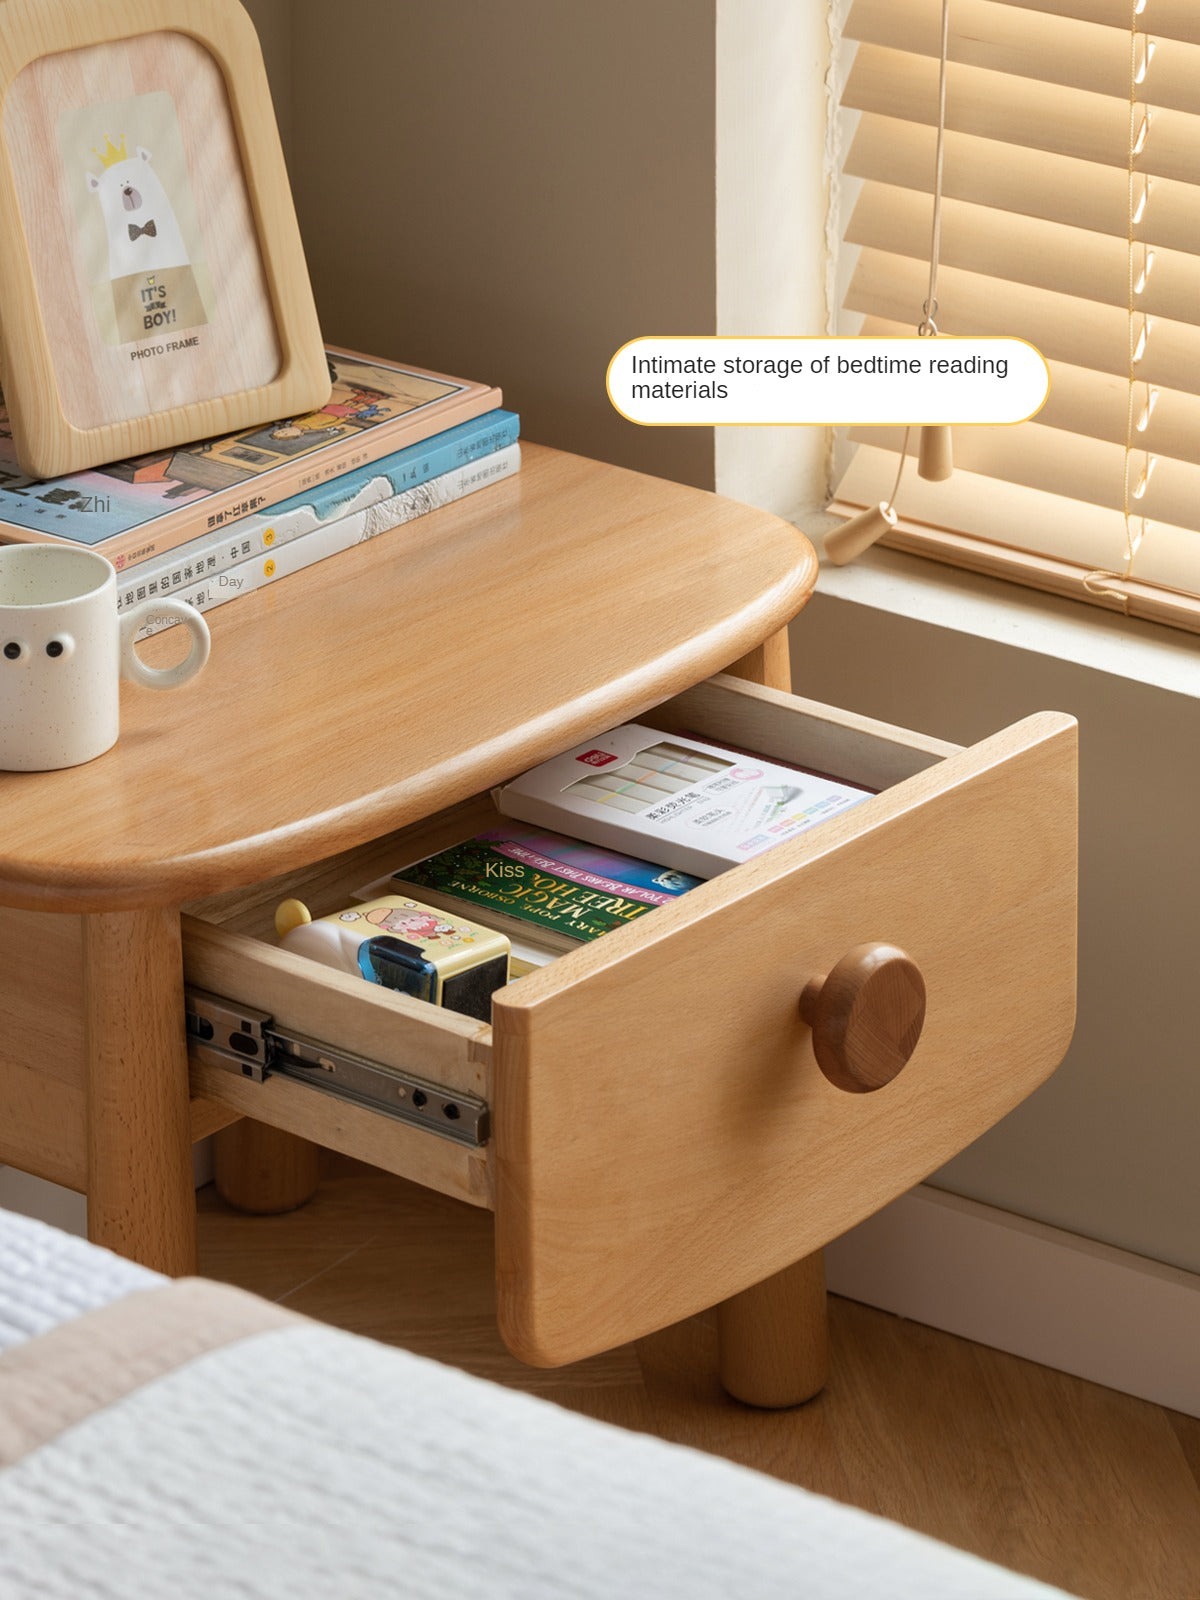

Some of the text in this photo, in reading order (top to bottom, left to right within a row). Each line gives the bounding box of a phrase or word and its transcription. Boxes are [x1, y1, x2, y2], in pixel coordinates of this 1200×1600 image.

[141, 285, 167, 303] IT'S
[143, 309, 177, 330] BOY!
[130, 336, 200, 361] PHOTO FRAME
[452, 881, 515, 905] OSBORNE
[499, 883, 593, 919] MAGIC
[572, 890, 648, 920] TREE
[520, 903, 561, 921] POPE
